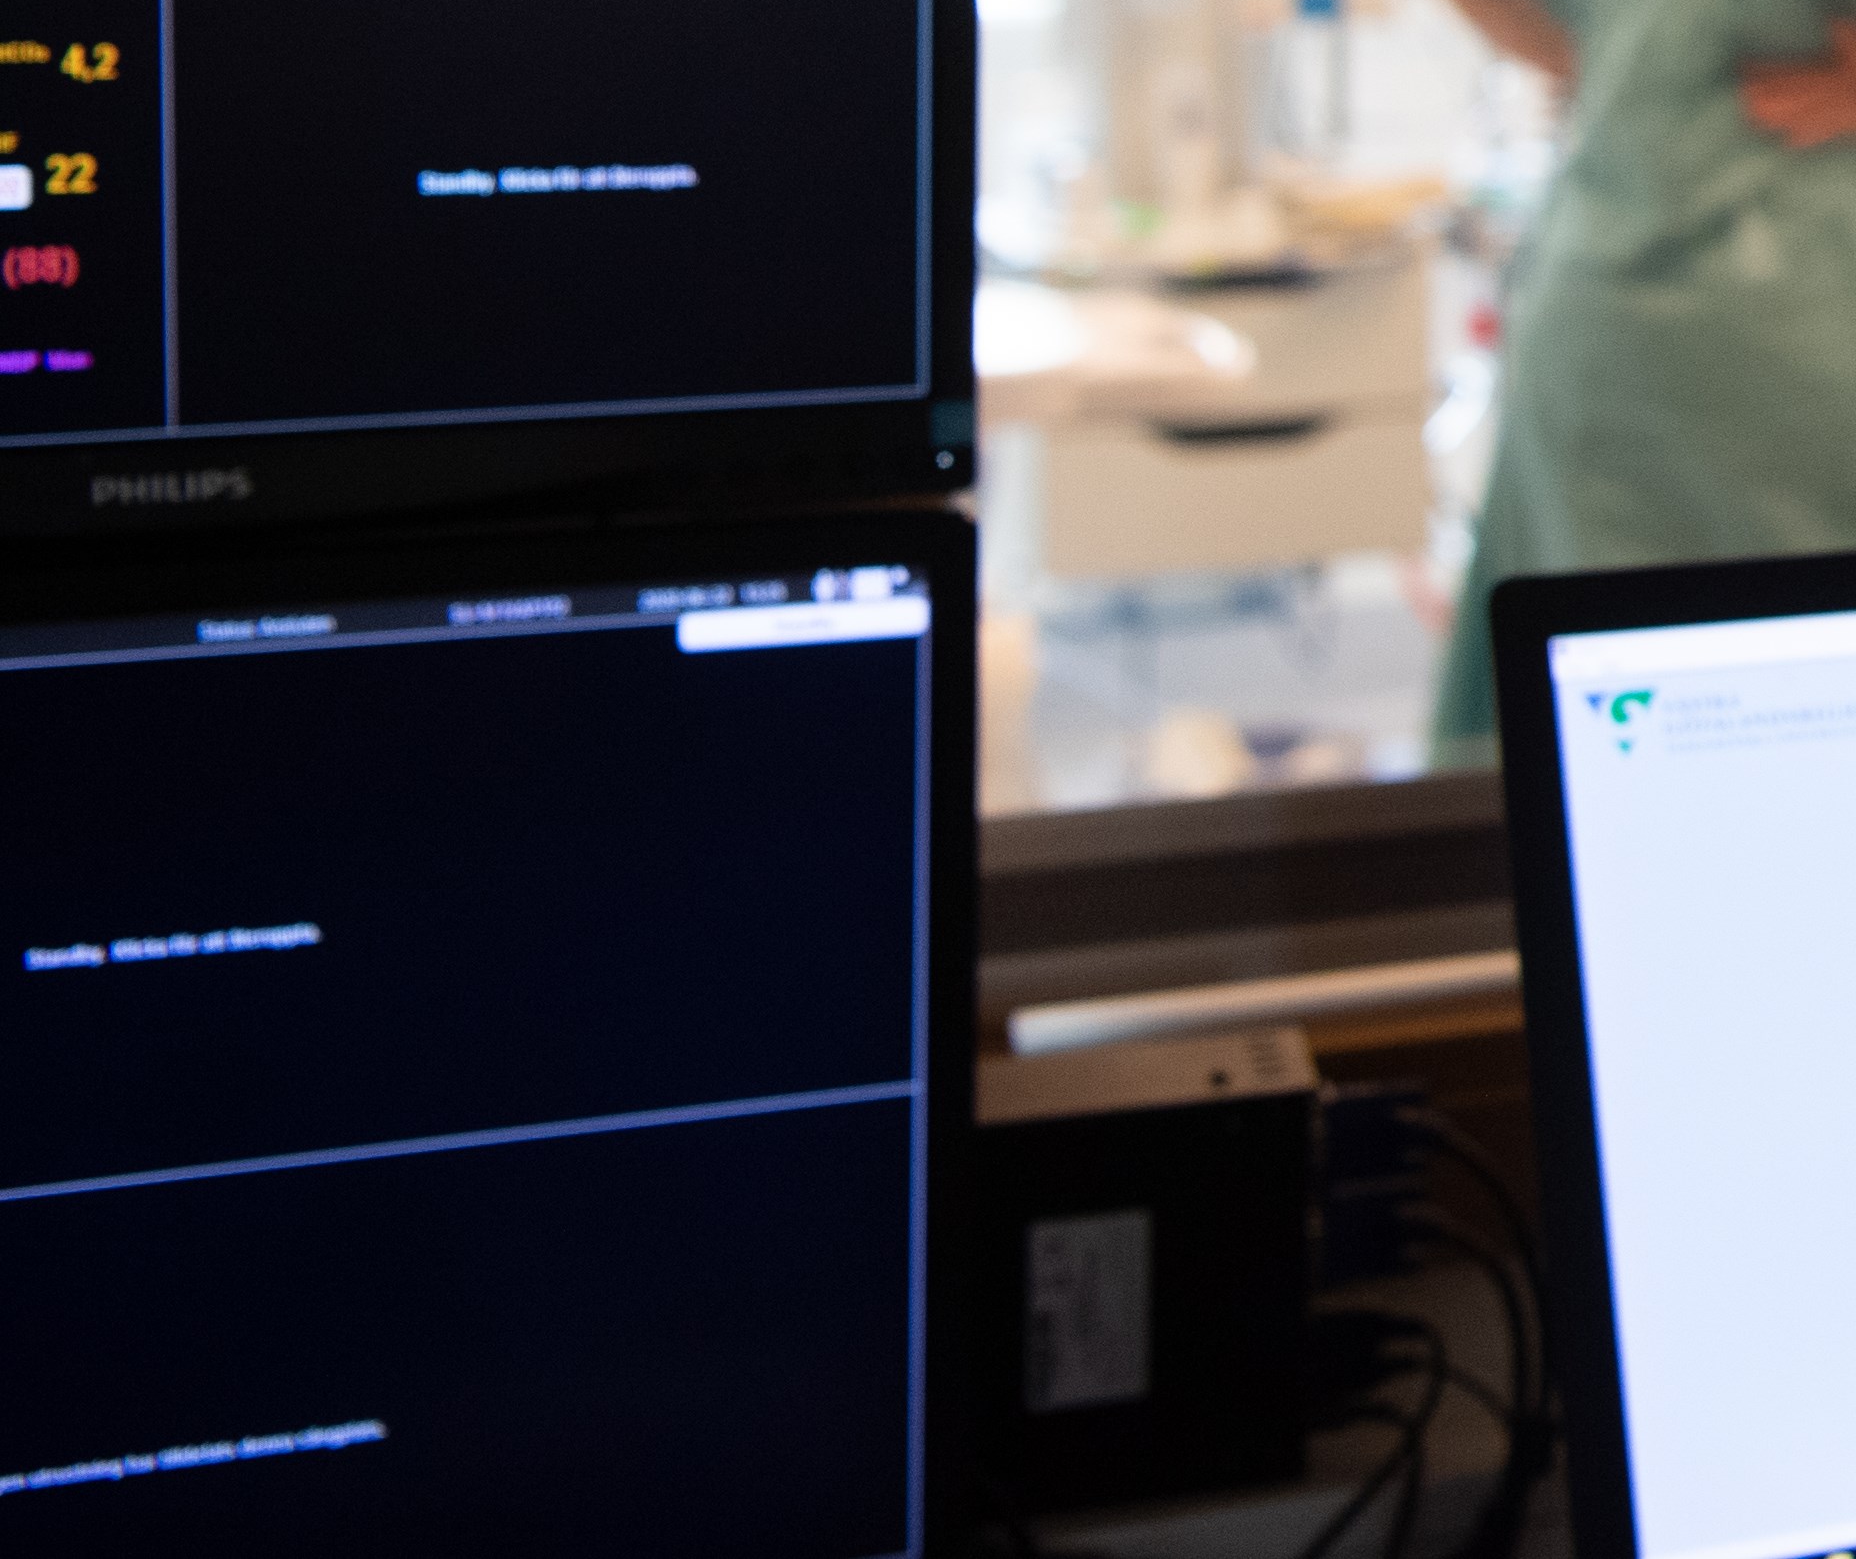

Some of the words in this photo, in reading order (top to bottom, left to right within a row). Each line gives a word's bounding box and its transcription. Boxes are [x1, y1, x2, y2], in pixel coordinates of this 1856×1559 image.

[60, 42, 120, 83] 4,2
[45, 152, 98, 196] 22
[2, 244, 80, 289] (88)
[89, 468, 254, 509] PHILIPS
